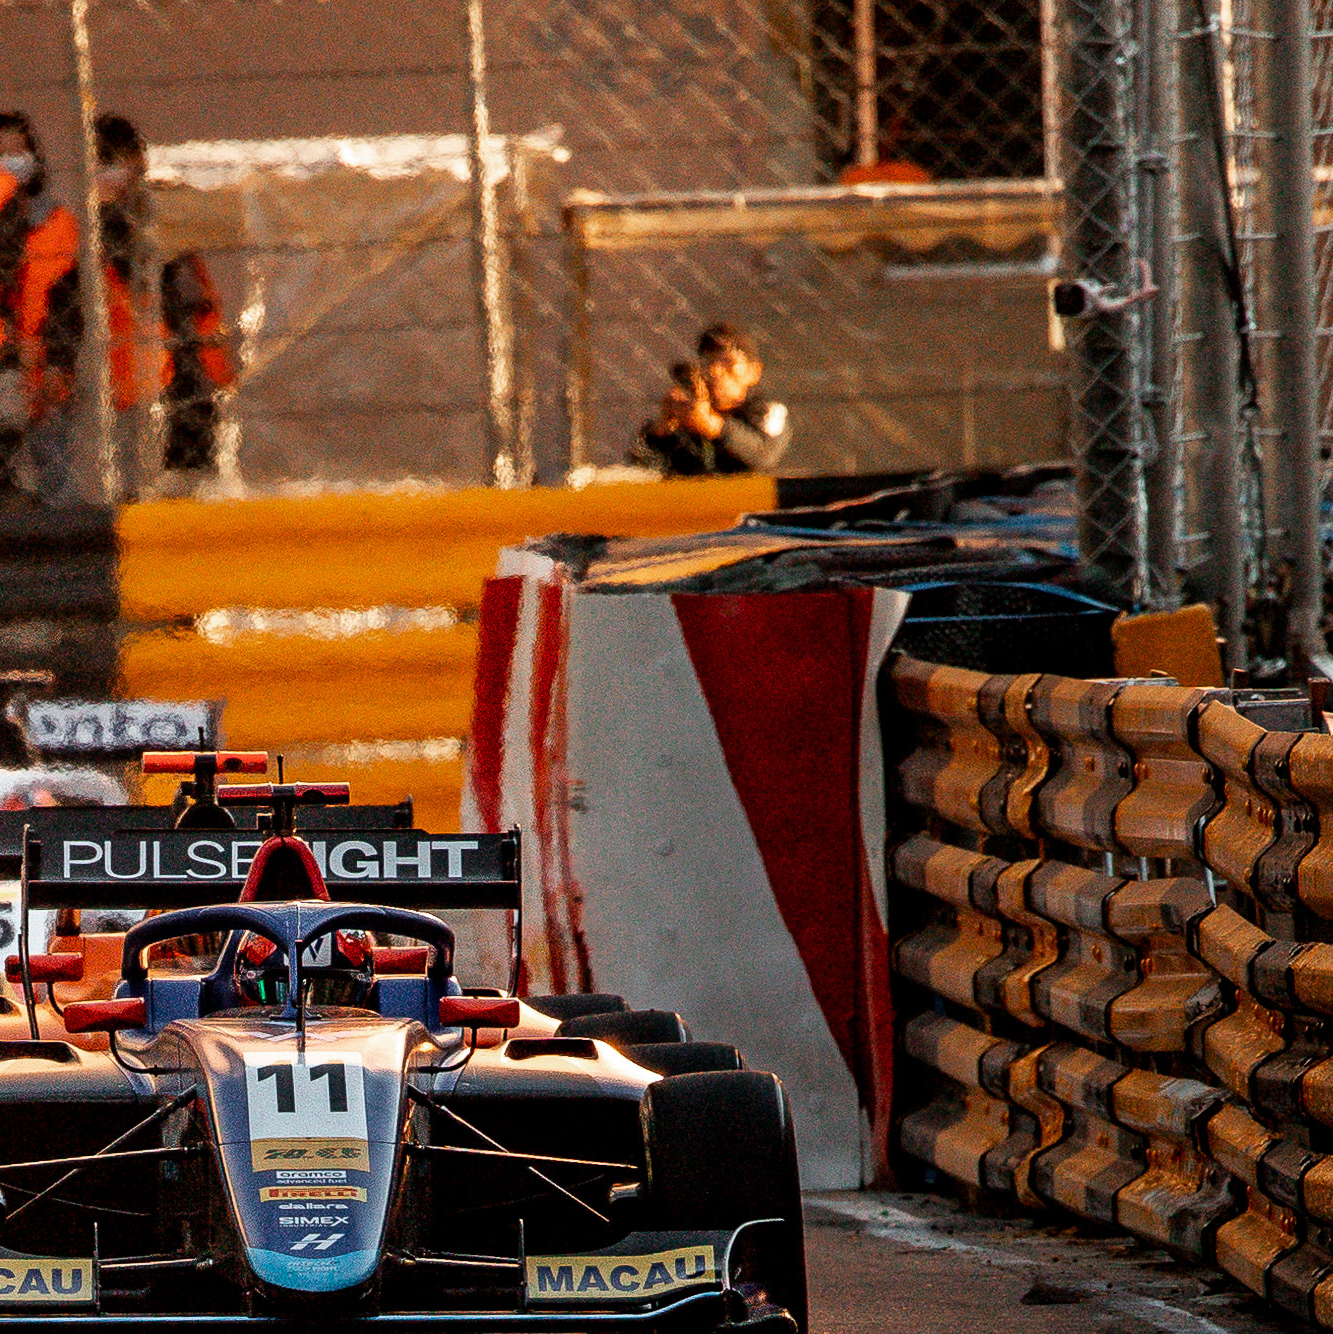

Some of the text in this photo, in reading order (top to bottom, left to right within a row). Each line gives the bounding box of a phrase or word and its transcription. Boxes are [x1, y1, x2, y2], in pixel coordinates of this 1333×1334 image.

[256, 1059, 349, 1113] 11
[279, 1170, 343, 1179] aramco
[278, 1202, 349, 1210] dallara
[279, 1215, 349, 1227] SIMEX
[536, 1254, 706, 1292] MACAU
